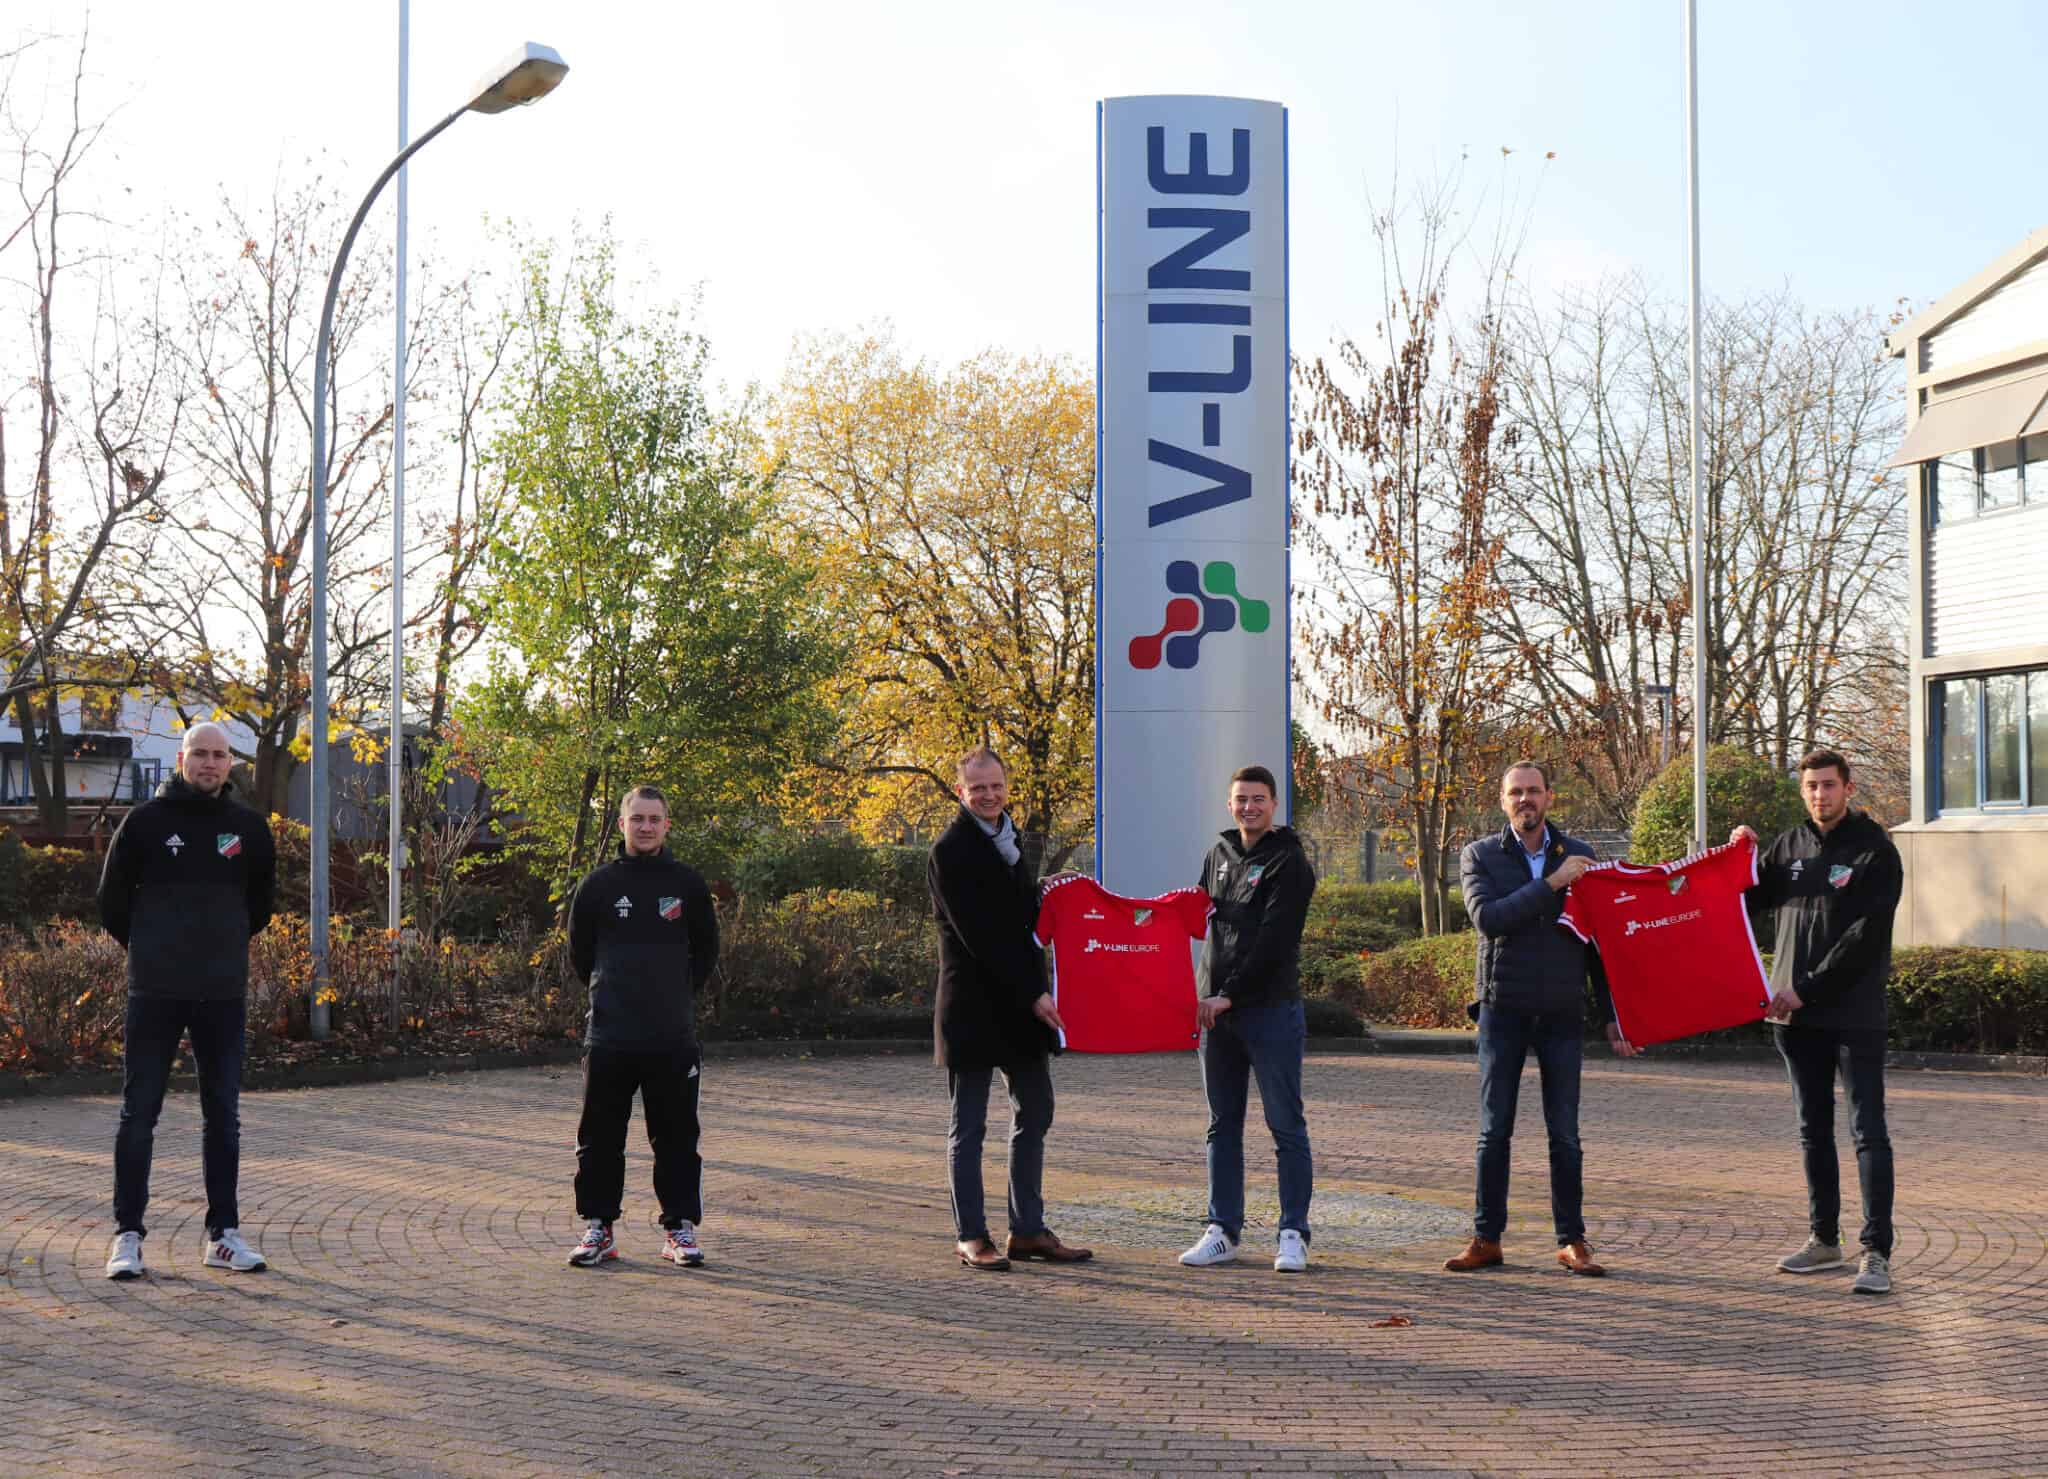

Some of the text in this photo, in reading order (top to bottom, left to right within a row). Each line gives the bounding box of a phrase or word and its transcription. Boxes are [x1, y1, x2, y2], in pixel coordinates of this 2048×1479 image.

[1147, 126, 1252, 528] V-LINE
[1642, 917, 1670, 928] V-LINE
[1103, 943, 1129, 952] V-LINE
